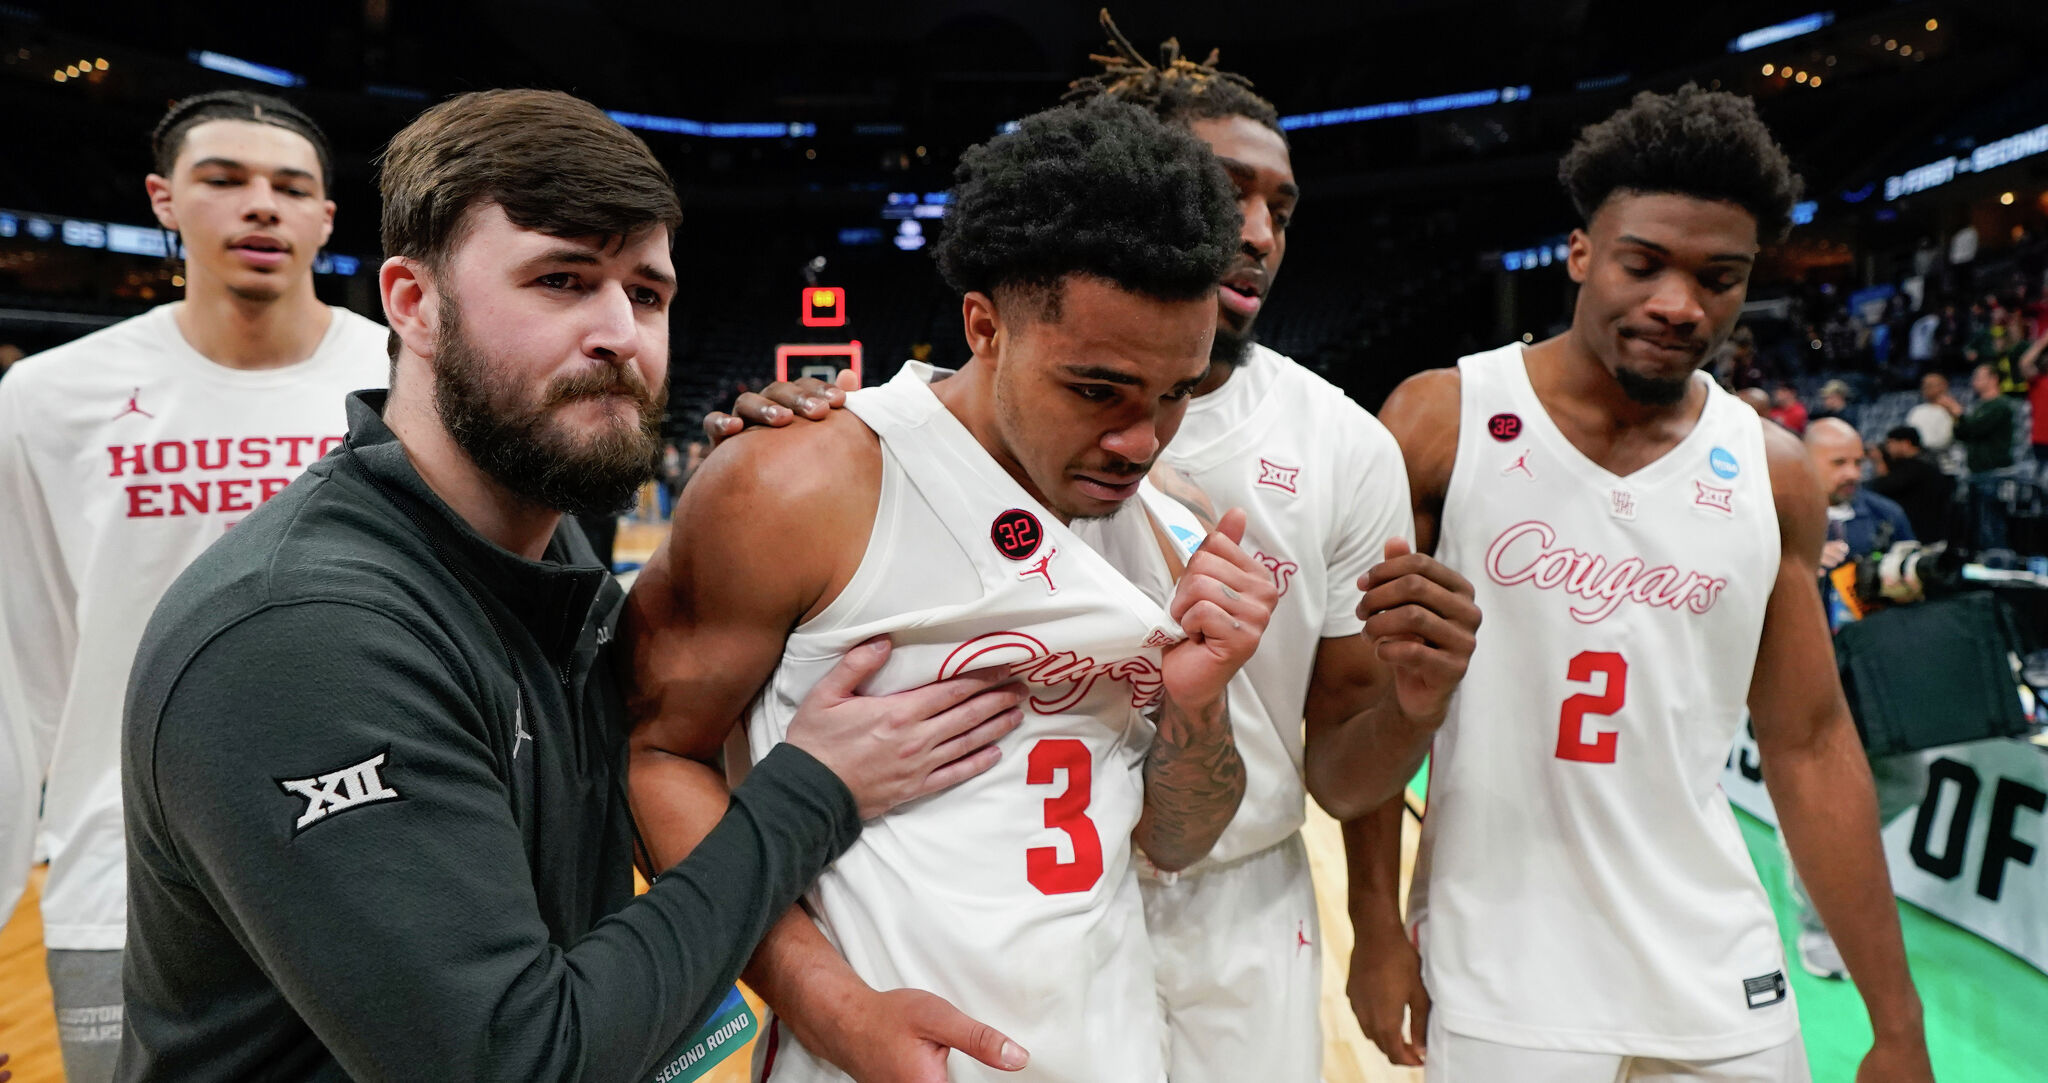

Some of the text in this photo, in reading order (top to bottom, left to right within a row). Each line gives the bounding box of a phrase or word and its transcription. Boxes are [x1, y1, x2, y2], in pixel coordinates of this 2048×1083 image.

[1493, 417, 1518, 436] 32
[998, 518, 1035, 551] 32
[1485, 520, 1728, 624] Cougars
[1555, 650, 1628, 764] 2
[282, 752, 399, 830] XII
[1026, 739, 1104, 896] 3
[1909, 756, 2047, 902] OF
[655, 1012, 750, 1083] SECOND ROUND
